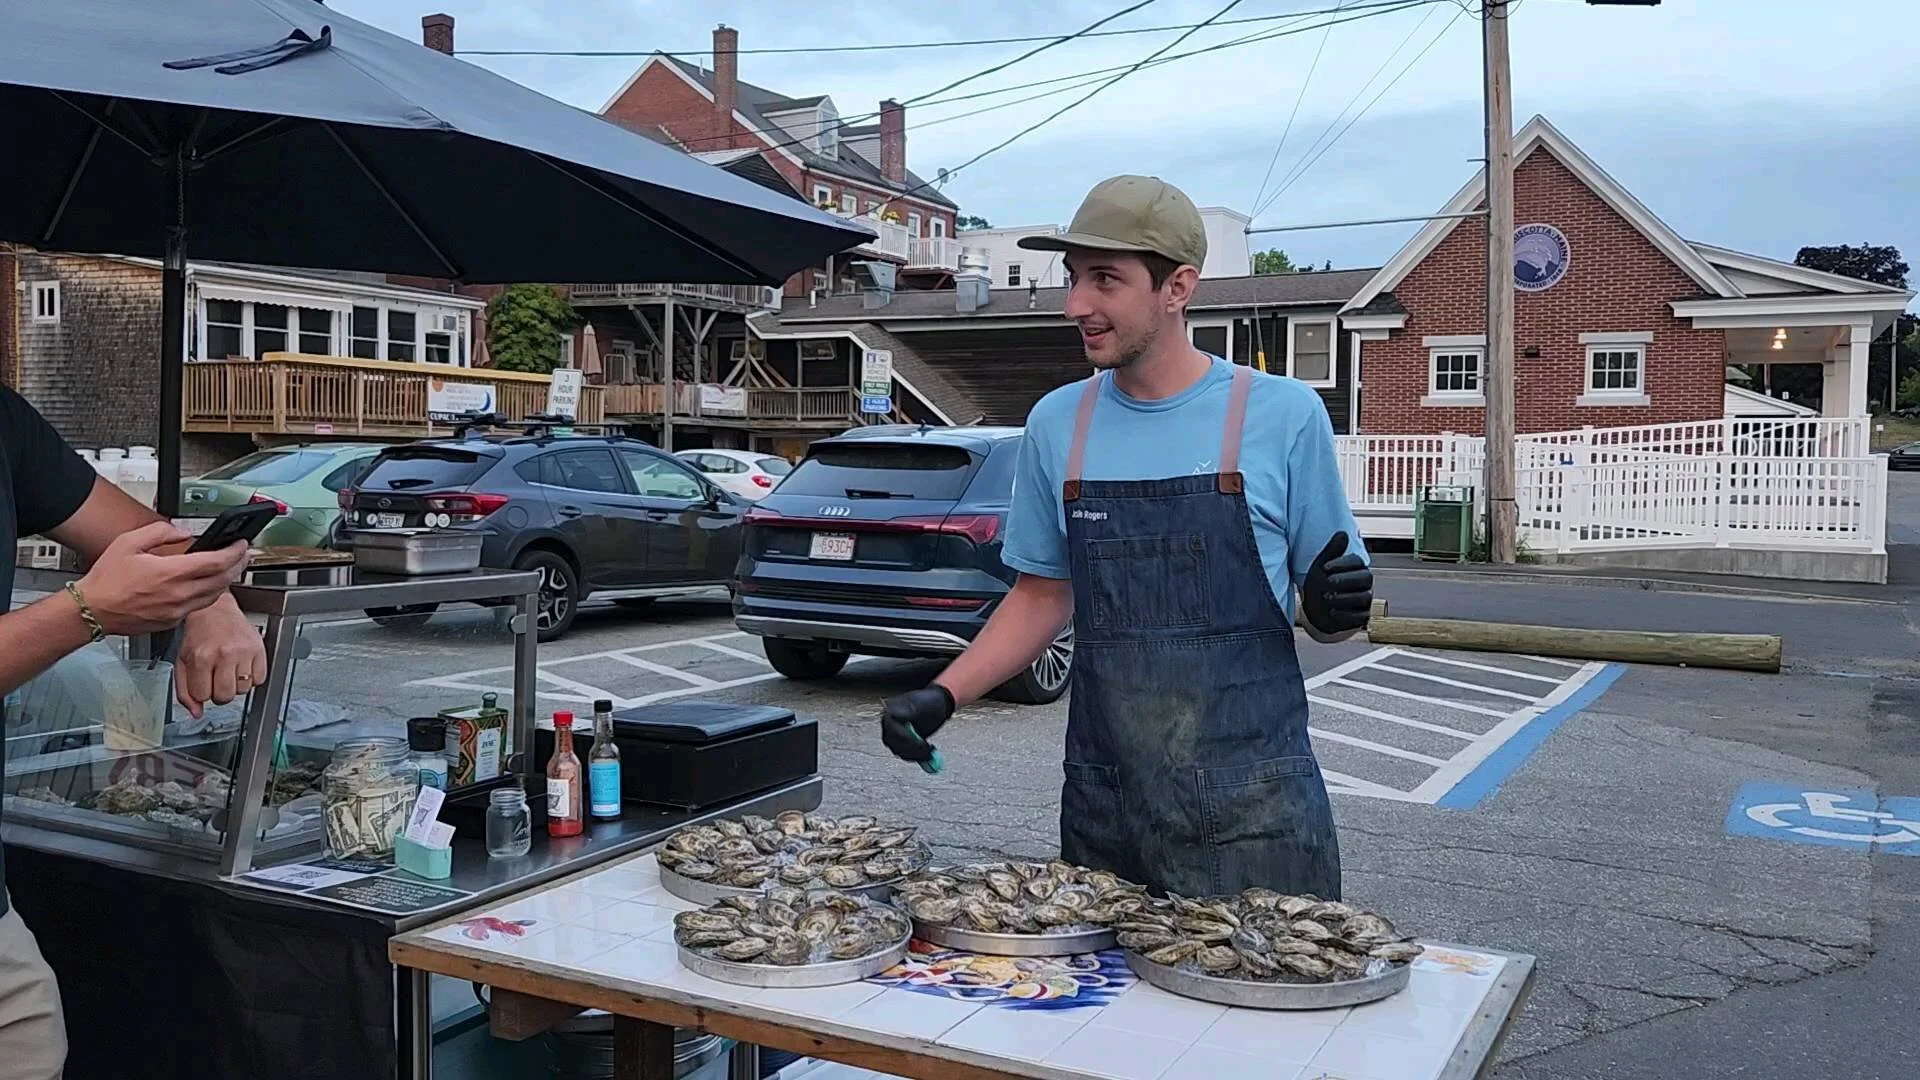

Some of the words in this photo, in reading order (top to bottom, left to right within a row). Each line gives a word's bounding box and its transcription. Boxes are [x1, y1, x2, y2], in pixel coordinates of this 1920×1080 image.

[557, 384, 574, 394] HOUR
[552, 395, 576, 405] PARKING
[1083, 510, 1108, 522] Rogers
